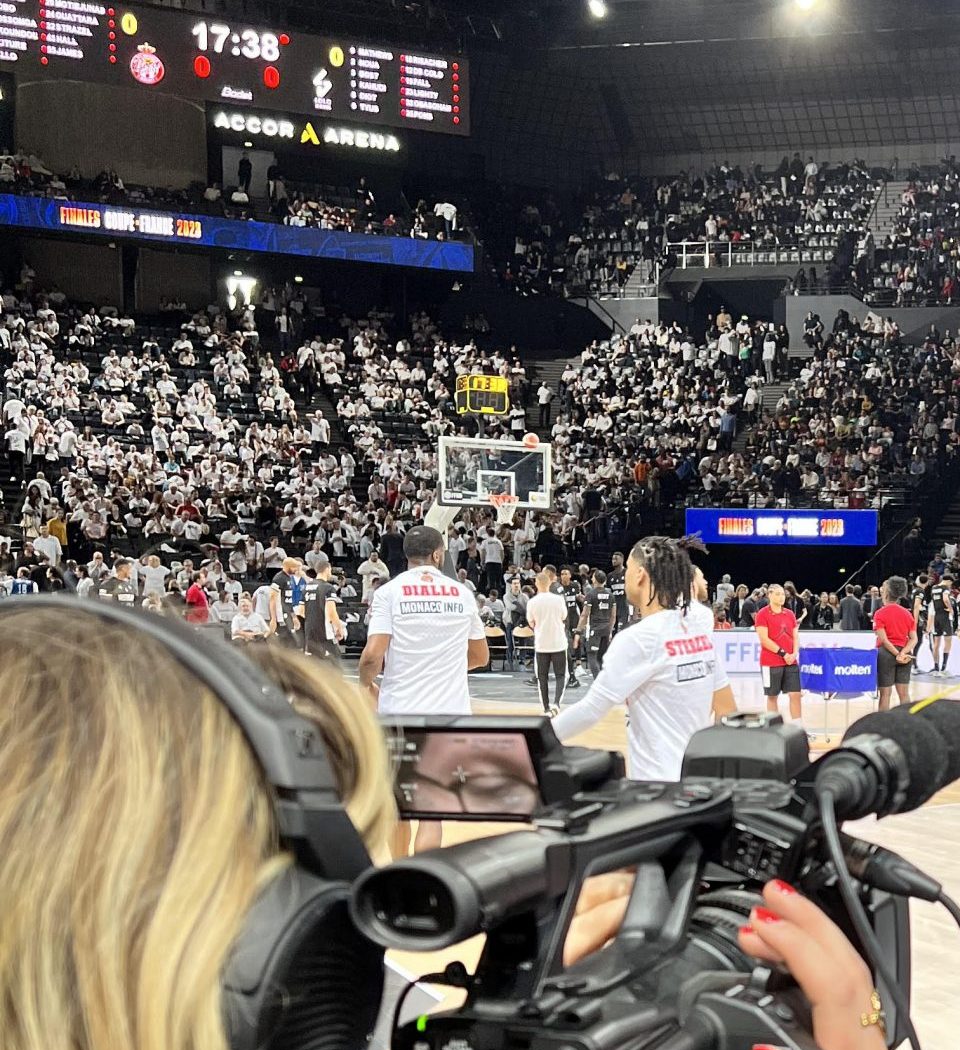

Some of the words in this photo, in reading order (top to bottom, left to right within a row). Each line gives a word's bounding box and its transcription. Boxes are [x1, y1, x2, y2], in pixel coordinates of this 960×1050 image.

[121, 13, 138, 35] 0
[192, 21, 280, 62] 17:38
[194, 55, 210, 78] 0
[329, 46, 344, 67] 0
[263, 65, 280, 88] 0
[214, 111, 295, 138] ACCOR
[324, 127, 400, 151] ARENA
[60, 206, 101, 228] FINALES
[718, 518, 754, 535] FINALES
[402, 584, 460, 597] DIALLO
[400, 601, 442, 614] MONACO
[443, 602, 464, 613] INFO
[725, 642, 761, 662] FF
[834, 664, 872, 676] molten
